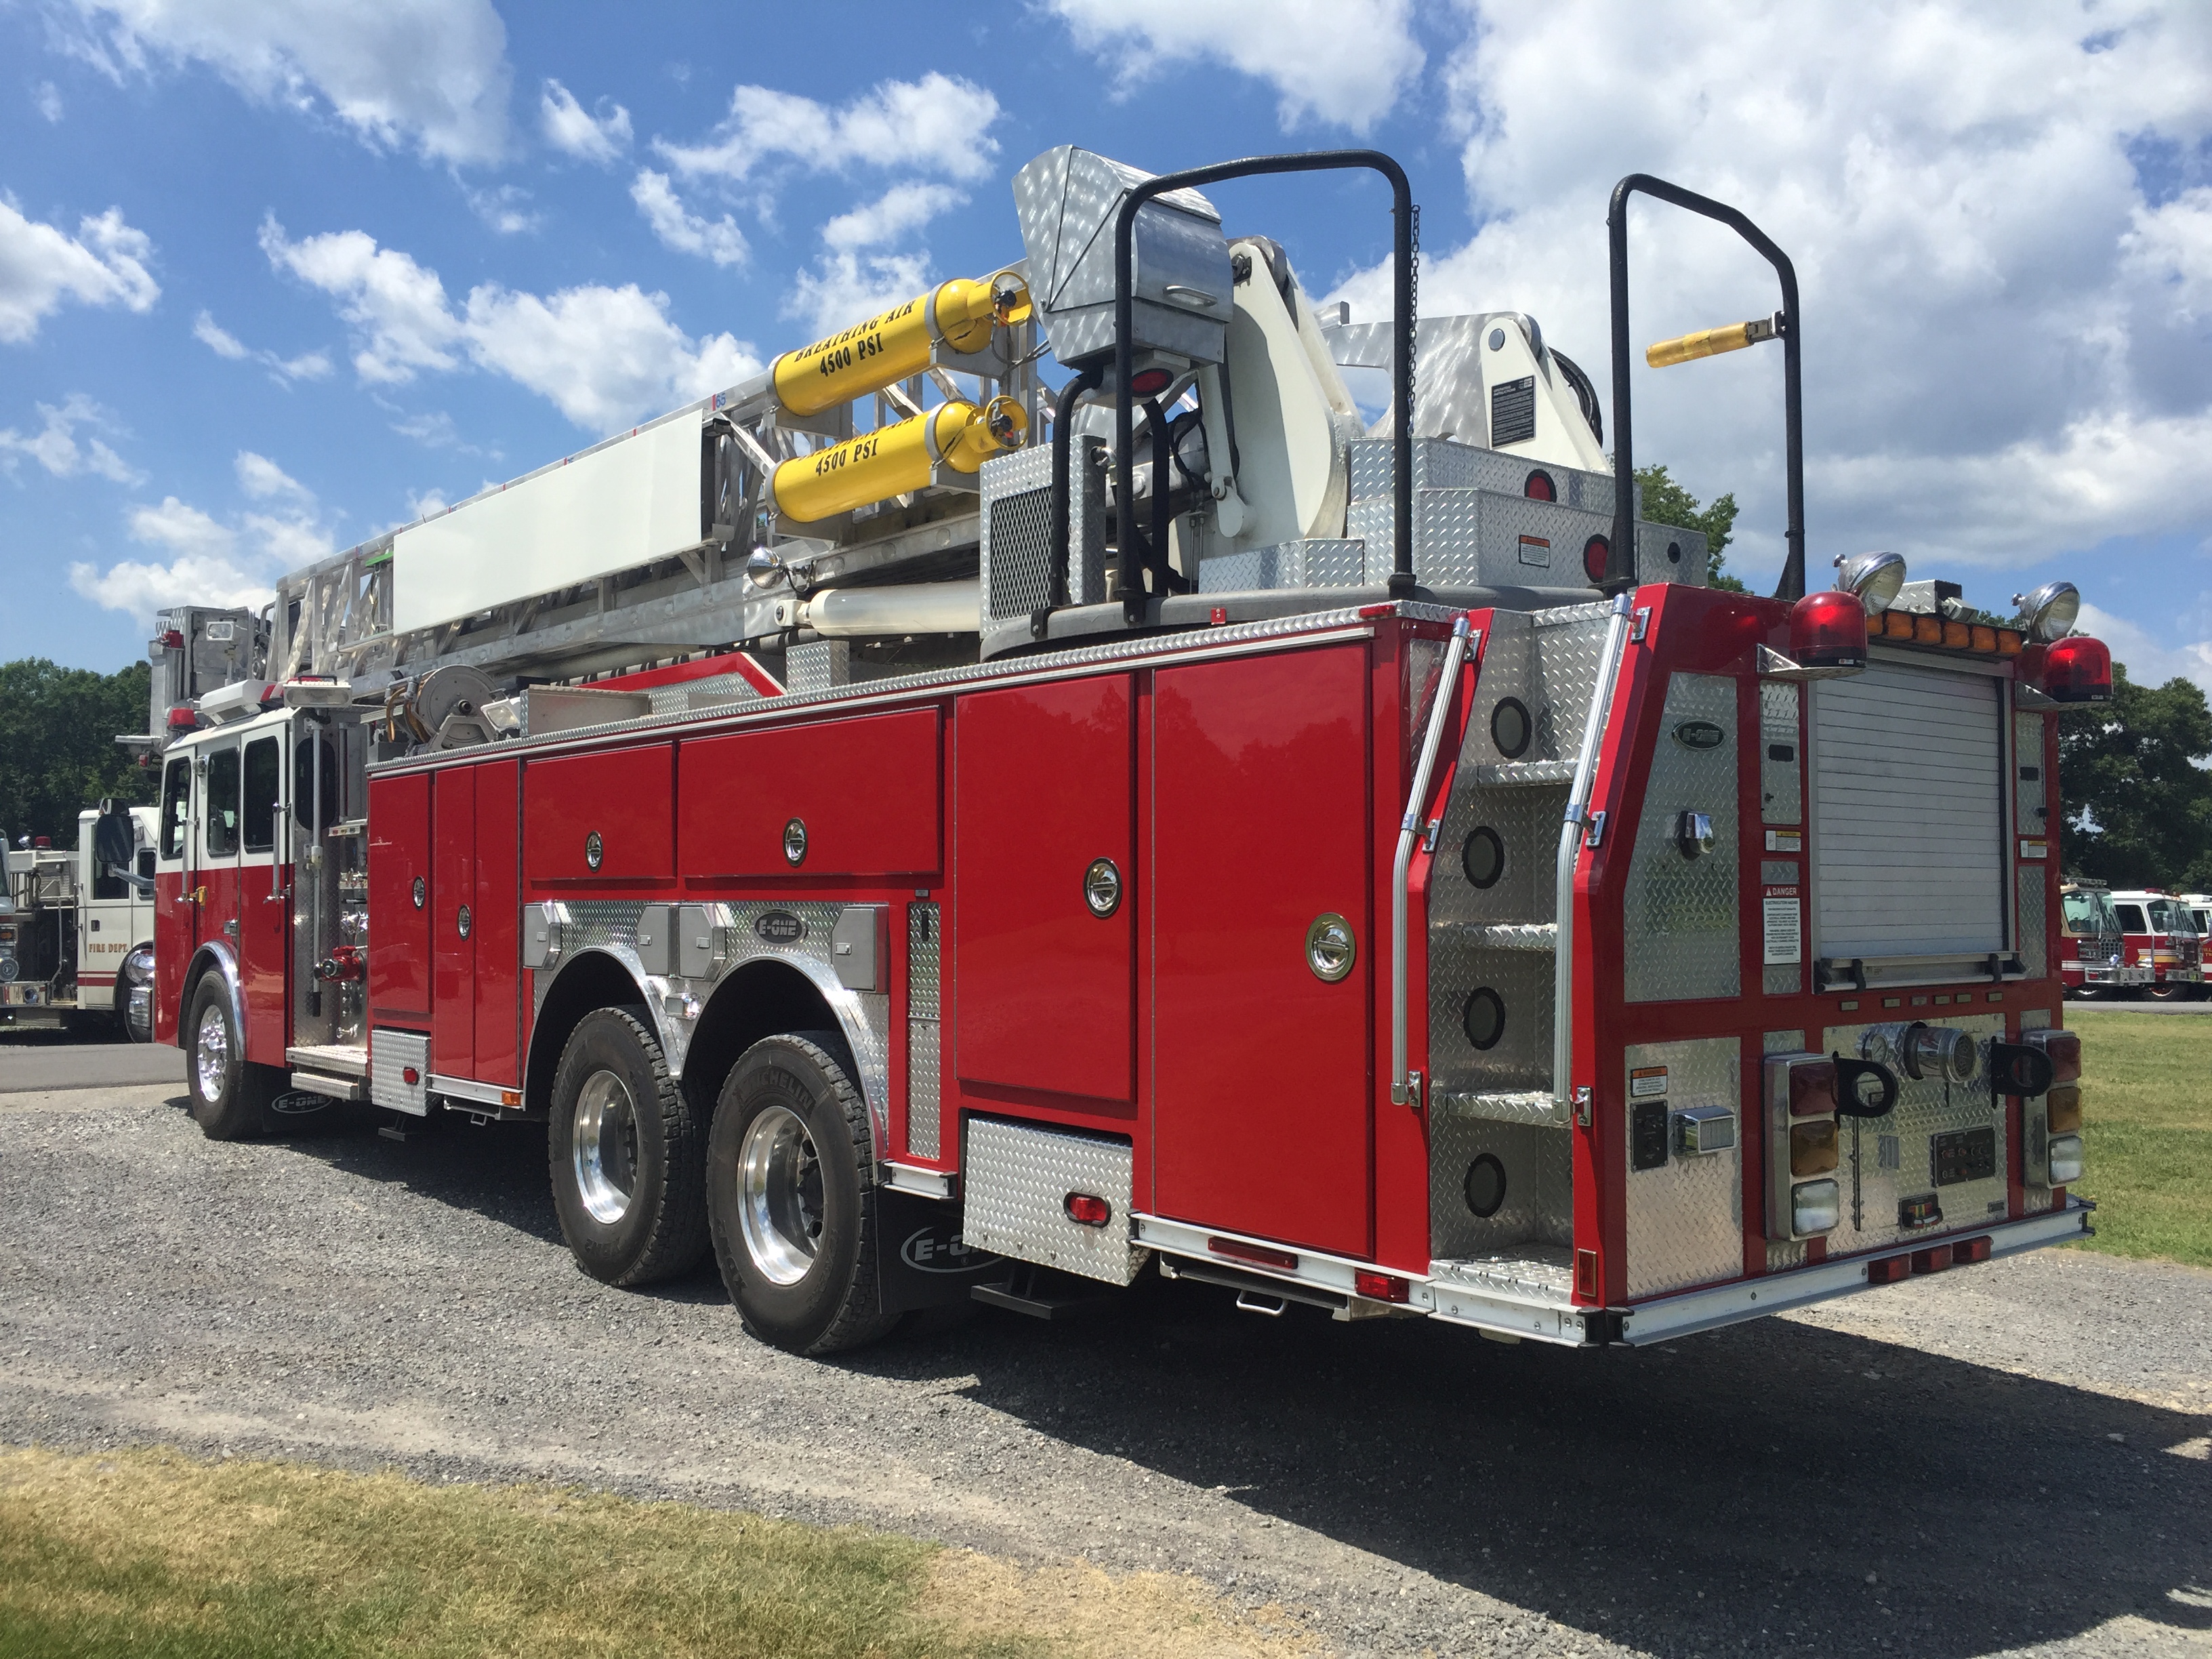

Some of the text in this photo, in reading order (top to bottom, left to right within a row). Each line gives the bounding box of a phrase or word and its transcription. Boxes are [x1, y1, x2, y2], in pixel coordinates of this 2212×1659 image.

[884, 300, 916, 324] AIR
[820, 332, 884, 377] 4500 PSI
[716, 392, 726, 408] 65
[815, 449, 848, 477] 4500
[853, 437, 879, 463] PSI
[1772, 887, 1797, 896] DANGER
[759, 918, 798, 936] E-ONE
[89, 943, 129, 953] FIRE DEPT.
[278, 1095, 327, 1109] E-ONE
[914, 1234, 980, 1262] E-O
